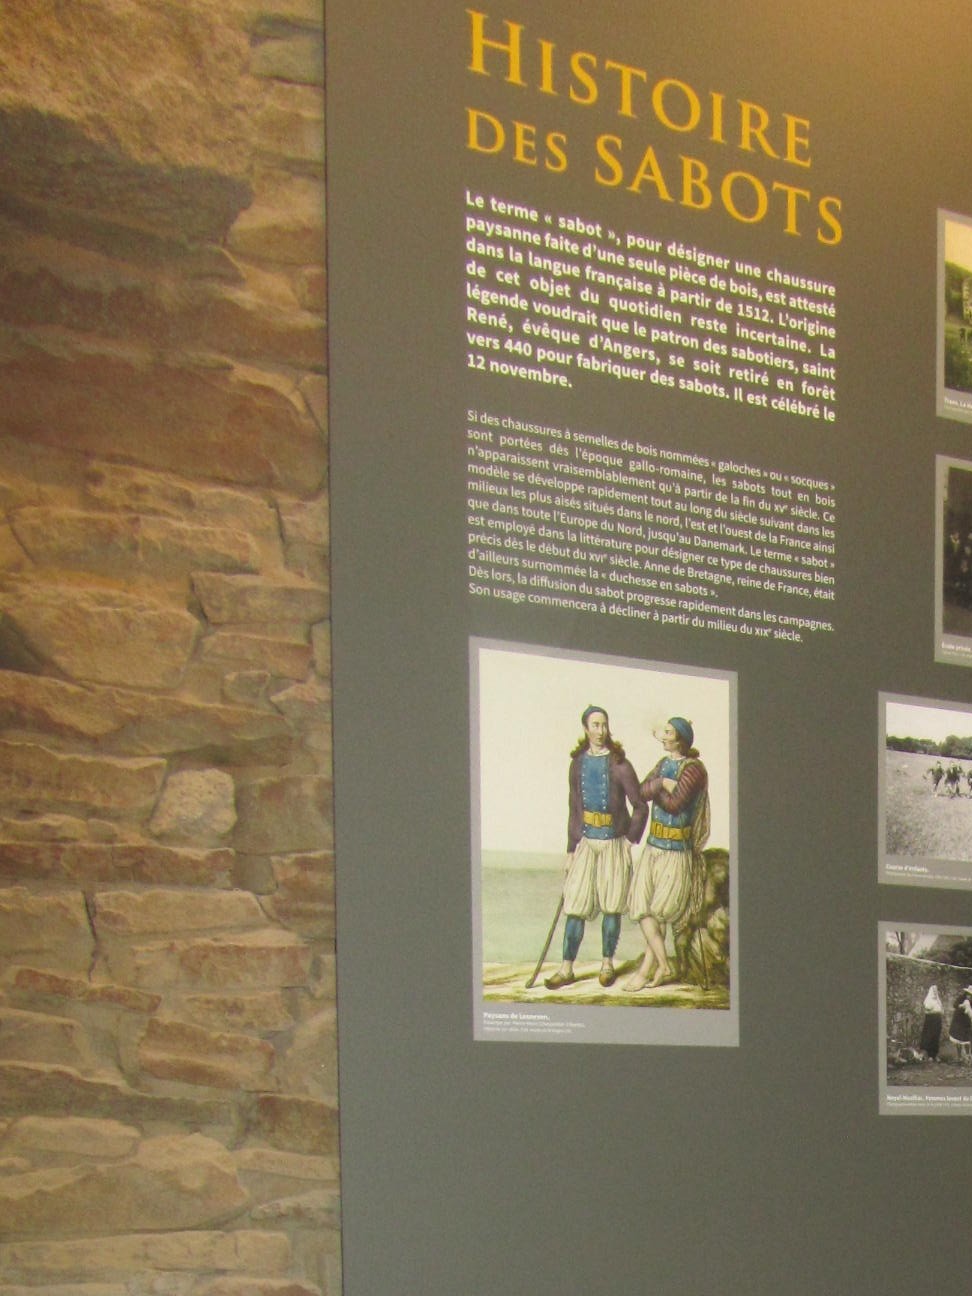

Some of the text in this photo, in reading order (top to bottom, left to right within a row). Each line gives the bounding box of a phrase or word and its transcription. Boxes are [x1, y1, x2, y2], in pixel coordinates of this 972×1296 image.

[465, 9, 811, 168] HISTOIRE
[465, 107, 843, 245] DES SABOTS
[465, 189, 484, 208] Le
[489, 196, 538, 221] terme
[557, 216, 602, 238] sabot
[625, 233, 662, 252] pour
[666, 241, 730, 269] désigner
[734, 260, 761, 278] une
[765, 267, 836, 296] chaussure
[465, 216, 836, 317] paysanne faite d'une seule pièce de bois, est attesté
[465, 237, 836, 338] dans la langue française à partir de 1512. L'origine
[465, 260, 835, 359] de cet objet du quotidien reste incertaine. La
[465, 282, 836, 380] légende voudrait que le patron des sabotiers, saint
[466, 305, 835, 401] René, évêque d'Angers, se soit retiré en forêt
[465, 331, 835, 421] vers 440 pour fabriquer des sabots. Il est célébré le
[466, 352, 572, 387] 12 novembre.
[466, 428, 836, 507] sont portées dès l'époque gallo-romaine, les sabots tout en bois
[467, 463, 835, 539] modèle se développe rapidement tout au long du siècle suivant dans les
[467, 564, 834, 631] Dès lors, la diffusion du sabot progresse rapidement dans les campagnes.
